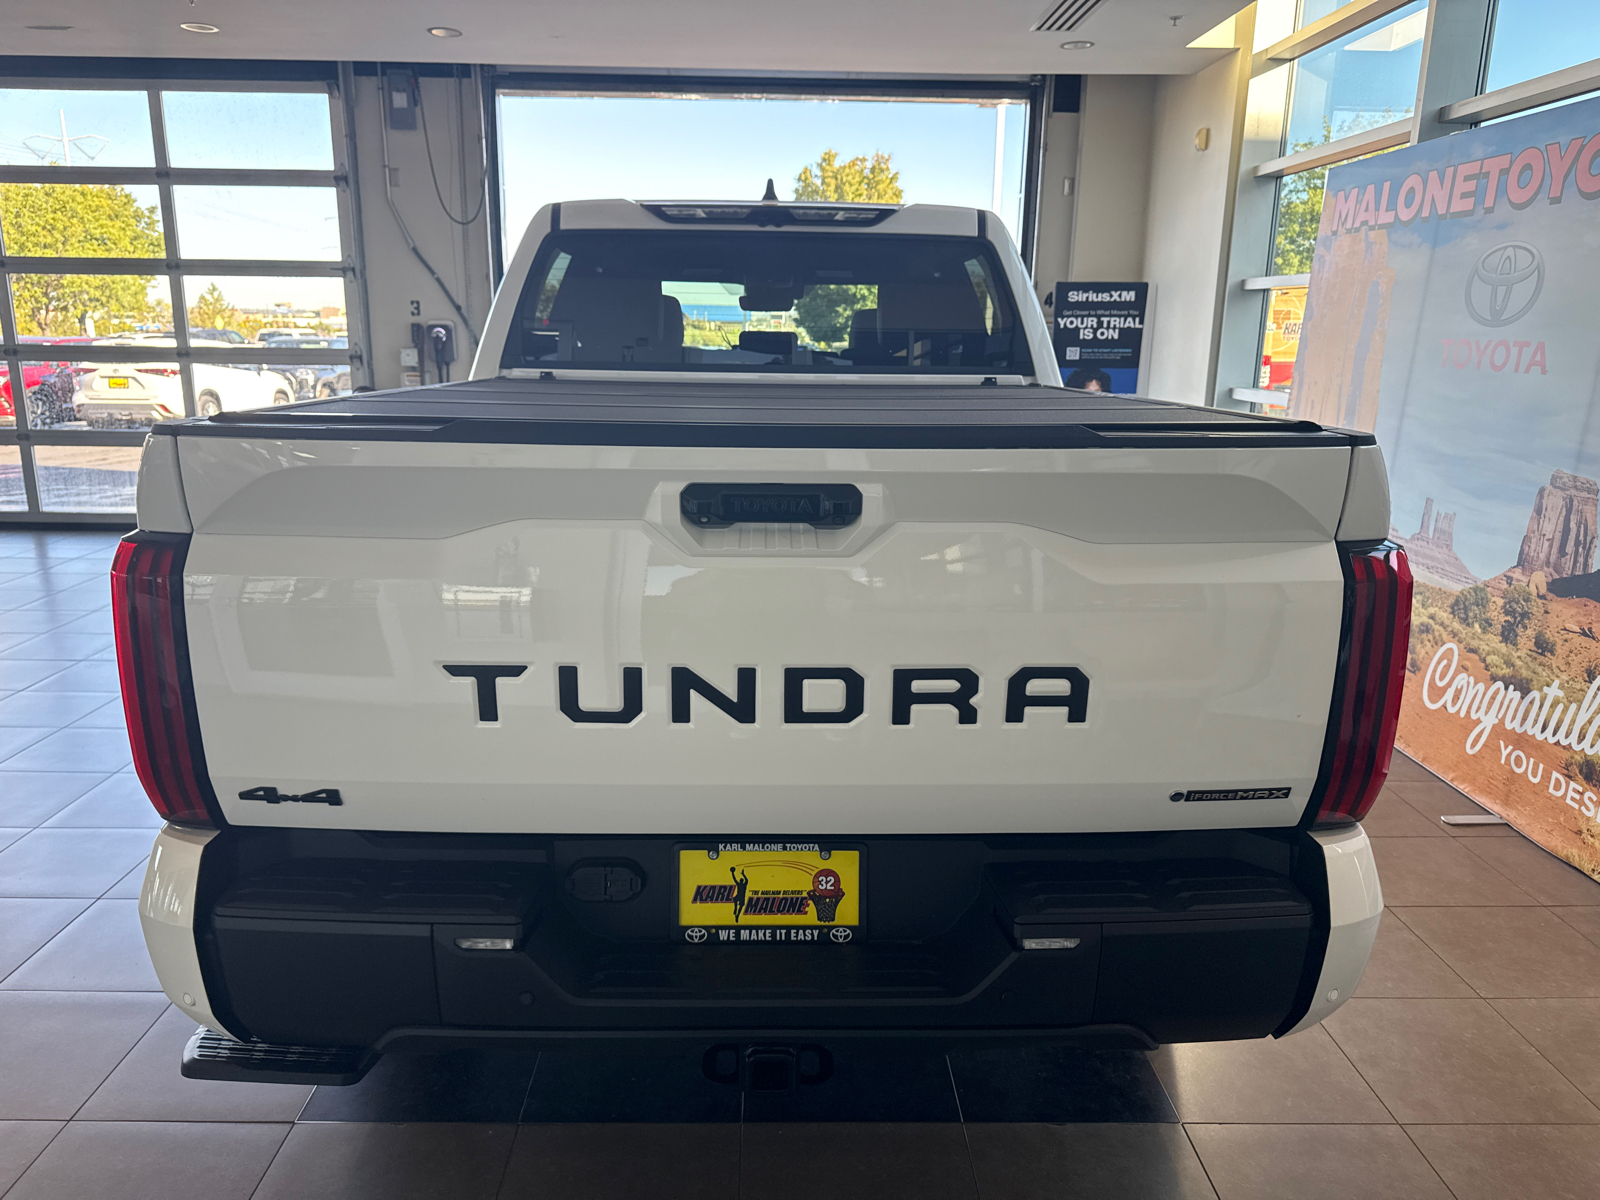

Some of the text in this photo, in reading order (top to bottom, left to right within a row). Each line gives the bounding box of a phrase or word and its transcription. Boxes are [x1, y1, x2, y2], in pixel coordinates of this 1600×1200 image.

[1043, 291, 1054, 308] 4
[1067, 290, 1136, 302] SiriusXM
[410, 300, 421, 317] 3
[1057, 317, 1144, 328] YOUR TRIAL
[1079, 328, 1120, 340] IS ON
[1440, 338, 1548, 375] TOYOTA
[729, 498, 814, 514] TOYOTA
[441, 664, 1091, 725] TUNDRA
[1499, 740, 1544, 784] YOU
[718, 843, 820, 851] KARL MALONE TOYOTA
[817, 876, 835, 890] 32
[691, 885, 737, 904] KARL
[743, 896, 810, 915] MALONE
[718, 929, 819, 941] WE MAKE IT EASY
